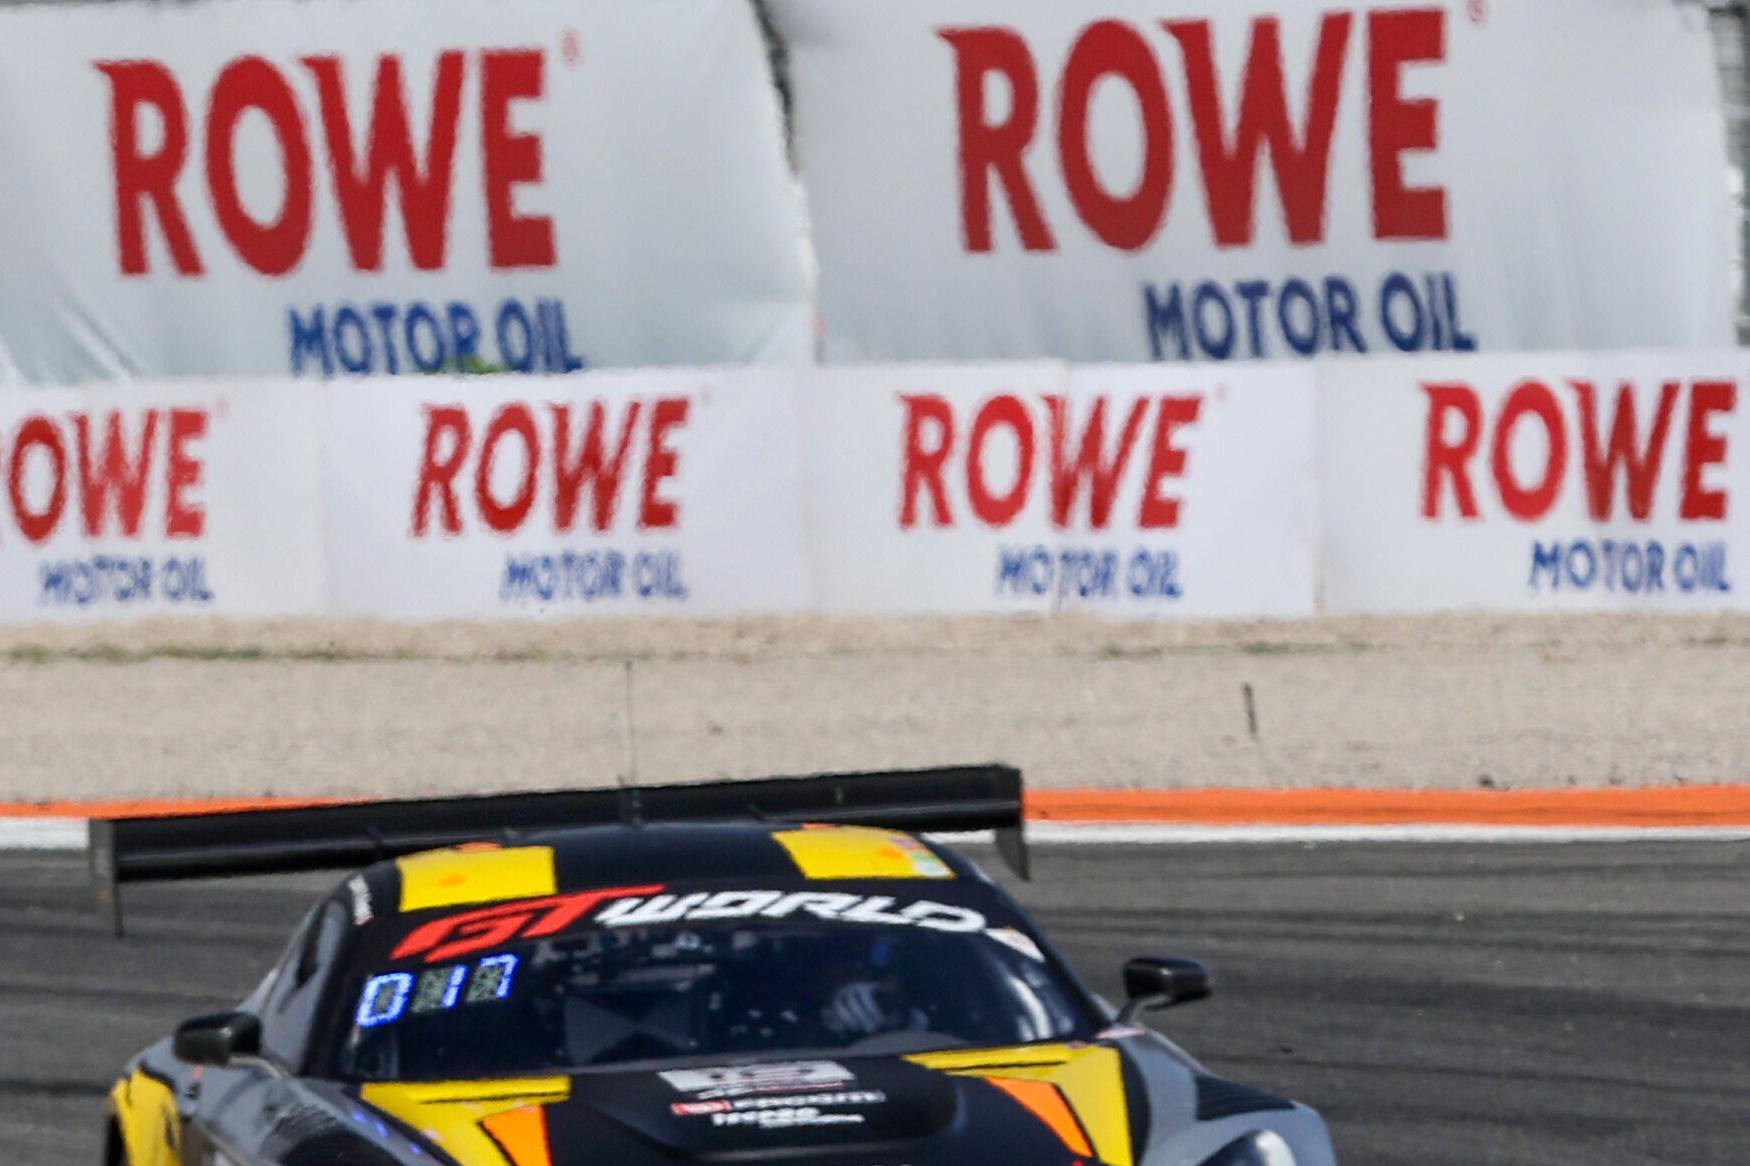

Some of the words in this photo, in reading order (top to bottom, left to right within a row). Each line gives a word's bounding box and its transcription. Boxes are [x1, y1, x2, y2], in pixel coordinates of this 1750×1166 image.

[91, 48, 557, 278] ROWE
[934, 6, 1451, 253] ROWE
[288, 302, 480, 377] MOTOR
[496, 298, 585, 373] OIL
[1142, 276, 1368, 360] MOTOR
[1379, 272, 1478, 353] OIL
[410, 400, 692, 538] ROWE
[897, 393, 1203, 531] ROWE
[1419, 379, 1737, 523] ROWE
[40, 559, 152, 606] MOTOR
[162, 556, 214, 602] OIL
[501, 553, 623, 602] MOTOR
[632, 551, 690, 600] OIL
[996, 546, 1118, 599] MOTOR
[1126, 547, 1182, 600] OIL
[1529, 541, 1665, 593] MOTOR
[1674, 541, 1731, 593] OIL
[391, 886, 664, 962] GT
[596, 889, 986, 932] WORLD
[355, 953, 520, 1028] 017
